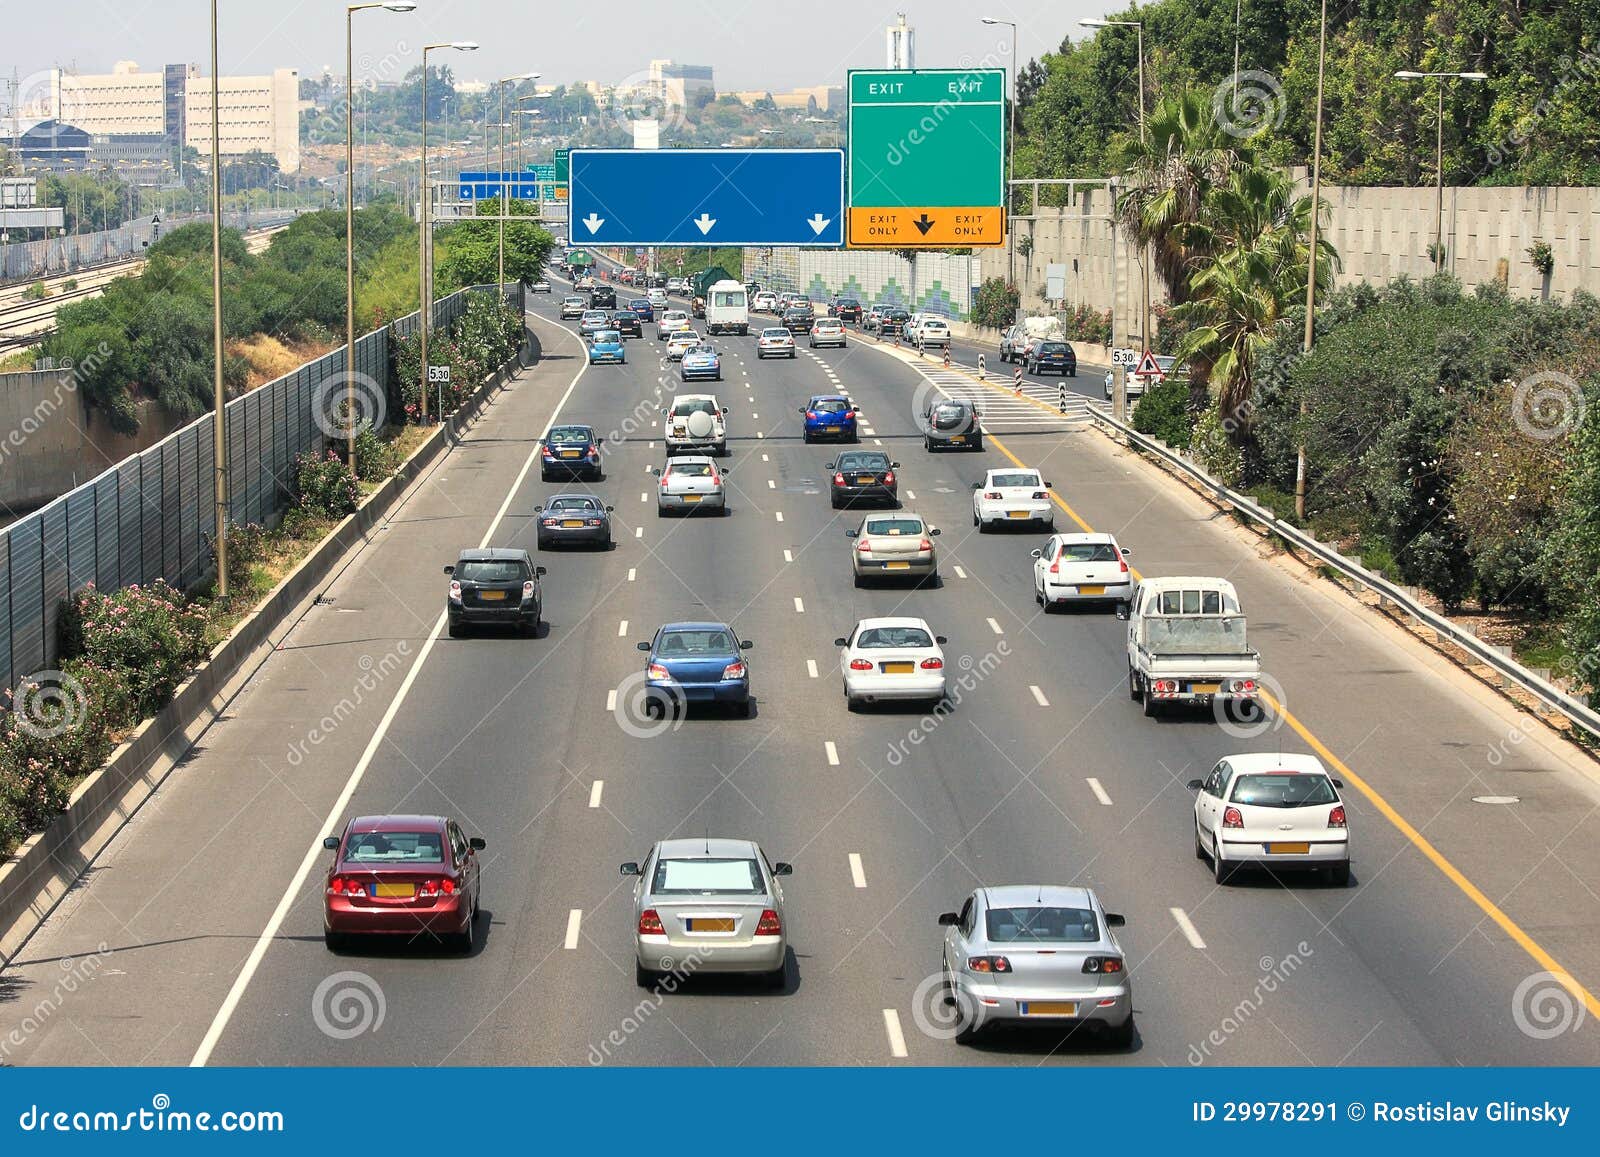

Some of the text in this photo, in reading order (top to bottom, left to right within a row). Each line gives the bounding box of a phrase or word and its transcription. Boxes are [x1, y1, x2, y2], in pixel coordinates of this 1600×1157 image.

[869, 83, 904, 94] EXIT
[948, 82, 983, 93] EXIT
[870, 215, 896, 223] EXIT
[955, 215, 982, 223] EXIT
[869, 227, 898, 235] ONLY
[954, 227, 983, 235] ONLY
[1113, 351, 1133, 362] 5.30
[430, 369, 448, 379] 5.30
